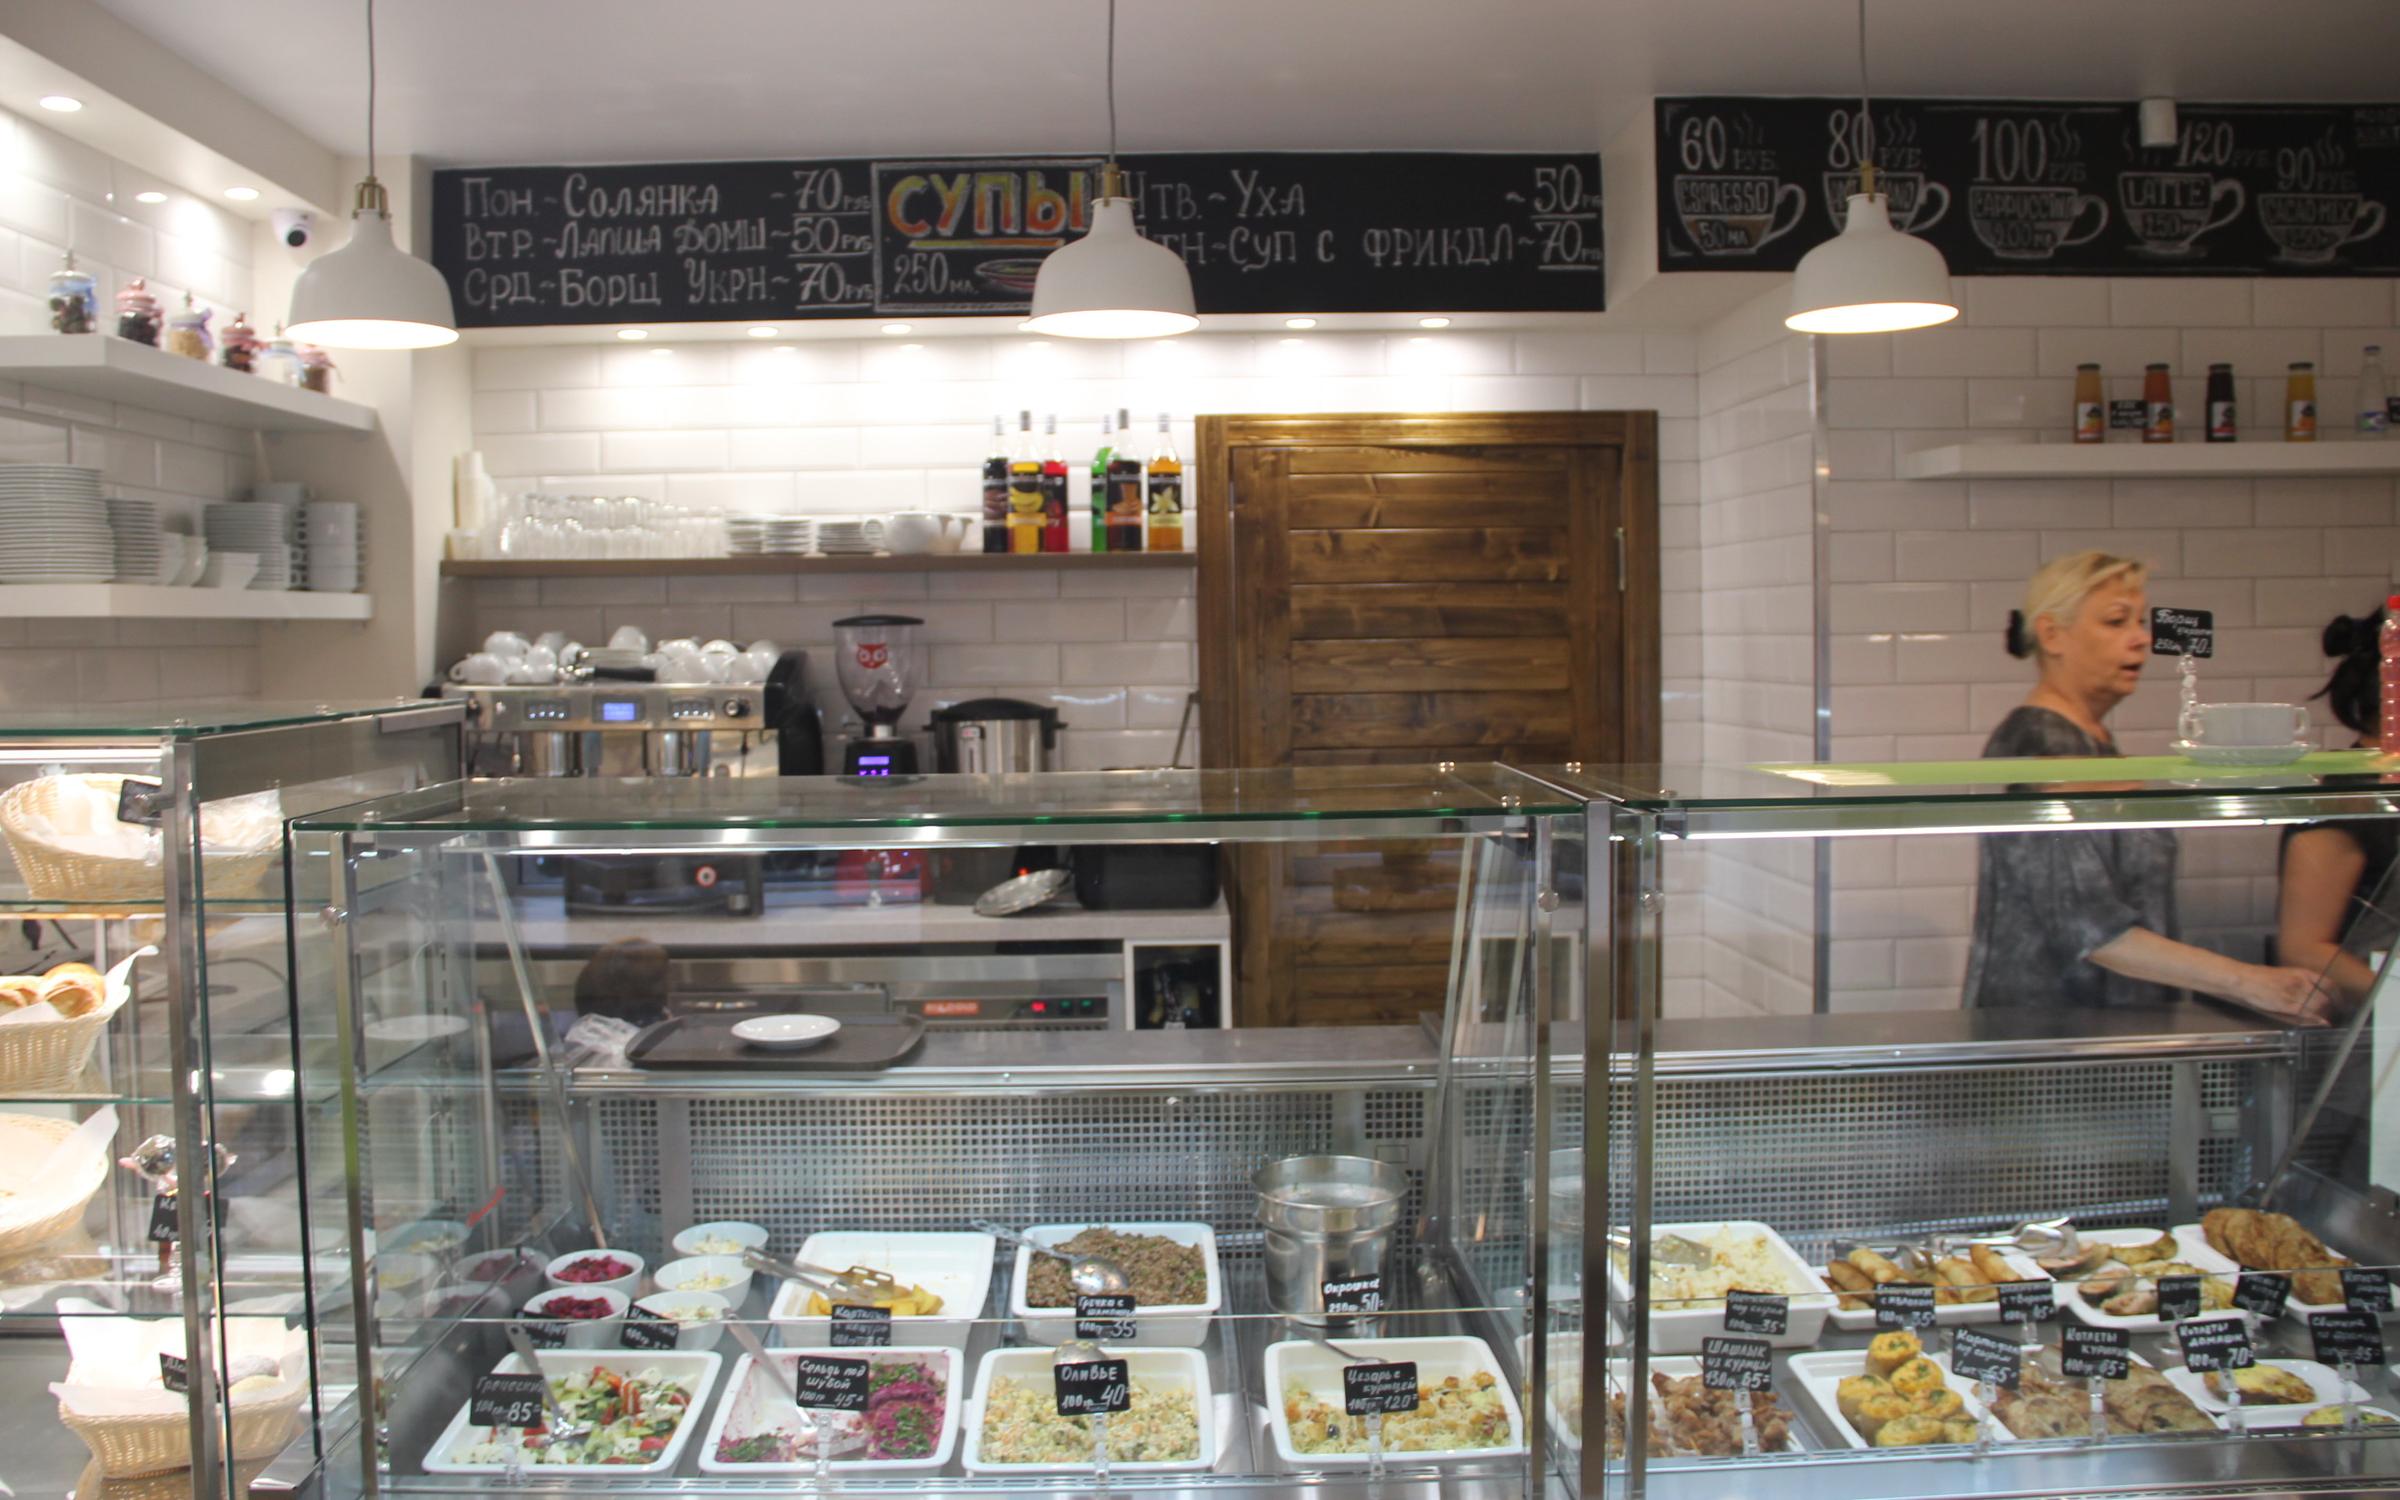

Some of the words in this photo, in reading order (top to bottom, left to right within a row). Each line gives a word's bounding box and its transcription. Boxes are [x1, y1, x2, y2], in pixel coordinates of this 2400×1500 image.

[1680, 115, 1727, 171] 60
[1828, 109, 1876, 169] 80
[1969, 117, 2048, 184] 100
[2173, 120, 2235, 168] 120
[563, 173, 720, 219] СОЛЯНКА
[792, 168, 843, 211] 70
[1229, 168, 1305, 219] УХА
[1534, 163, 1583, 212] 50
[2127, 177, 2206, 207] LATTE
[2276, 147, 2316, 192] 90
[888, 171, 1092, 239] СУПЫ
[1678, 180, 1771, 214] ESPRESSO
[555, 219, 661, 260] ЛАПША
[791, 216, 841, 254] 50
[1228, 225, 1298, 273] СУП
[1535, 220, 1583, 264] 70
[558, 267, 661, 308] БОРЩ
[795, 262, 845, 303] 70
[892, 252, 949, 294] 250
